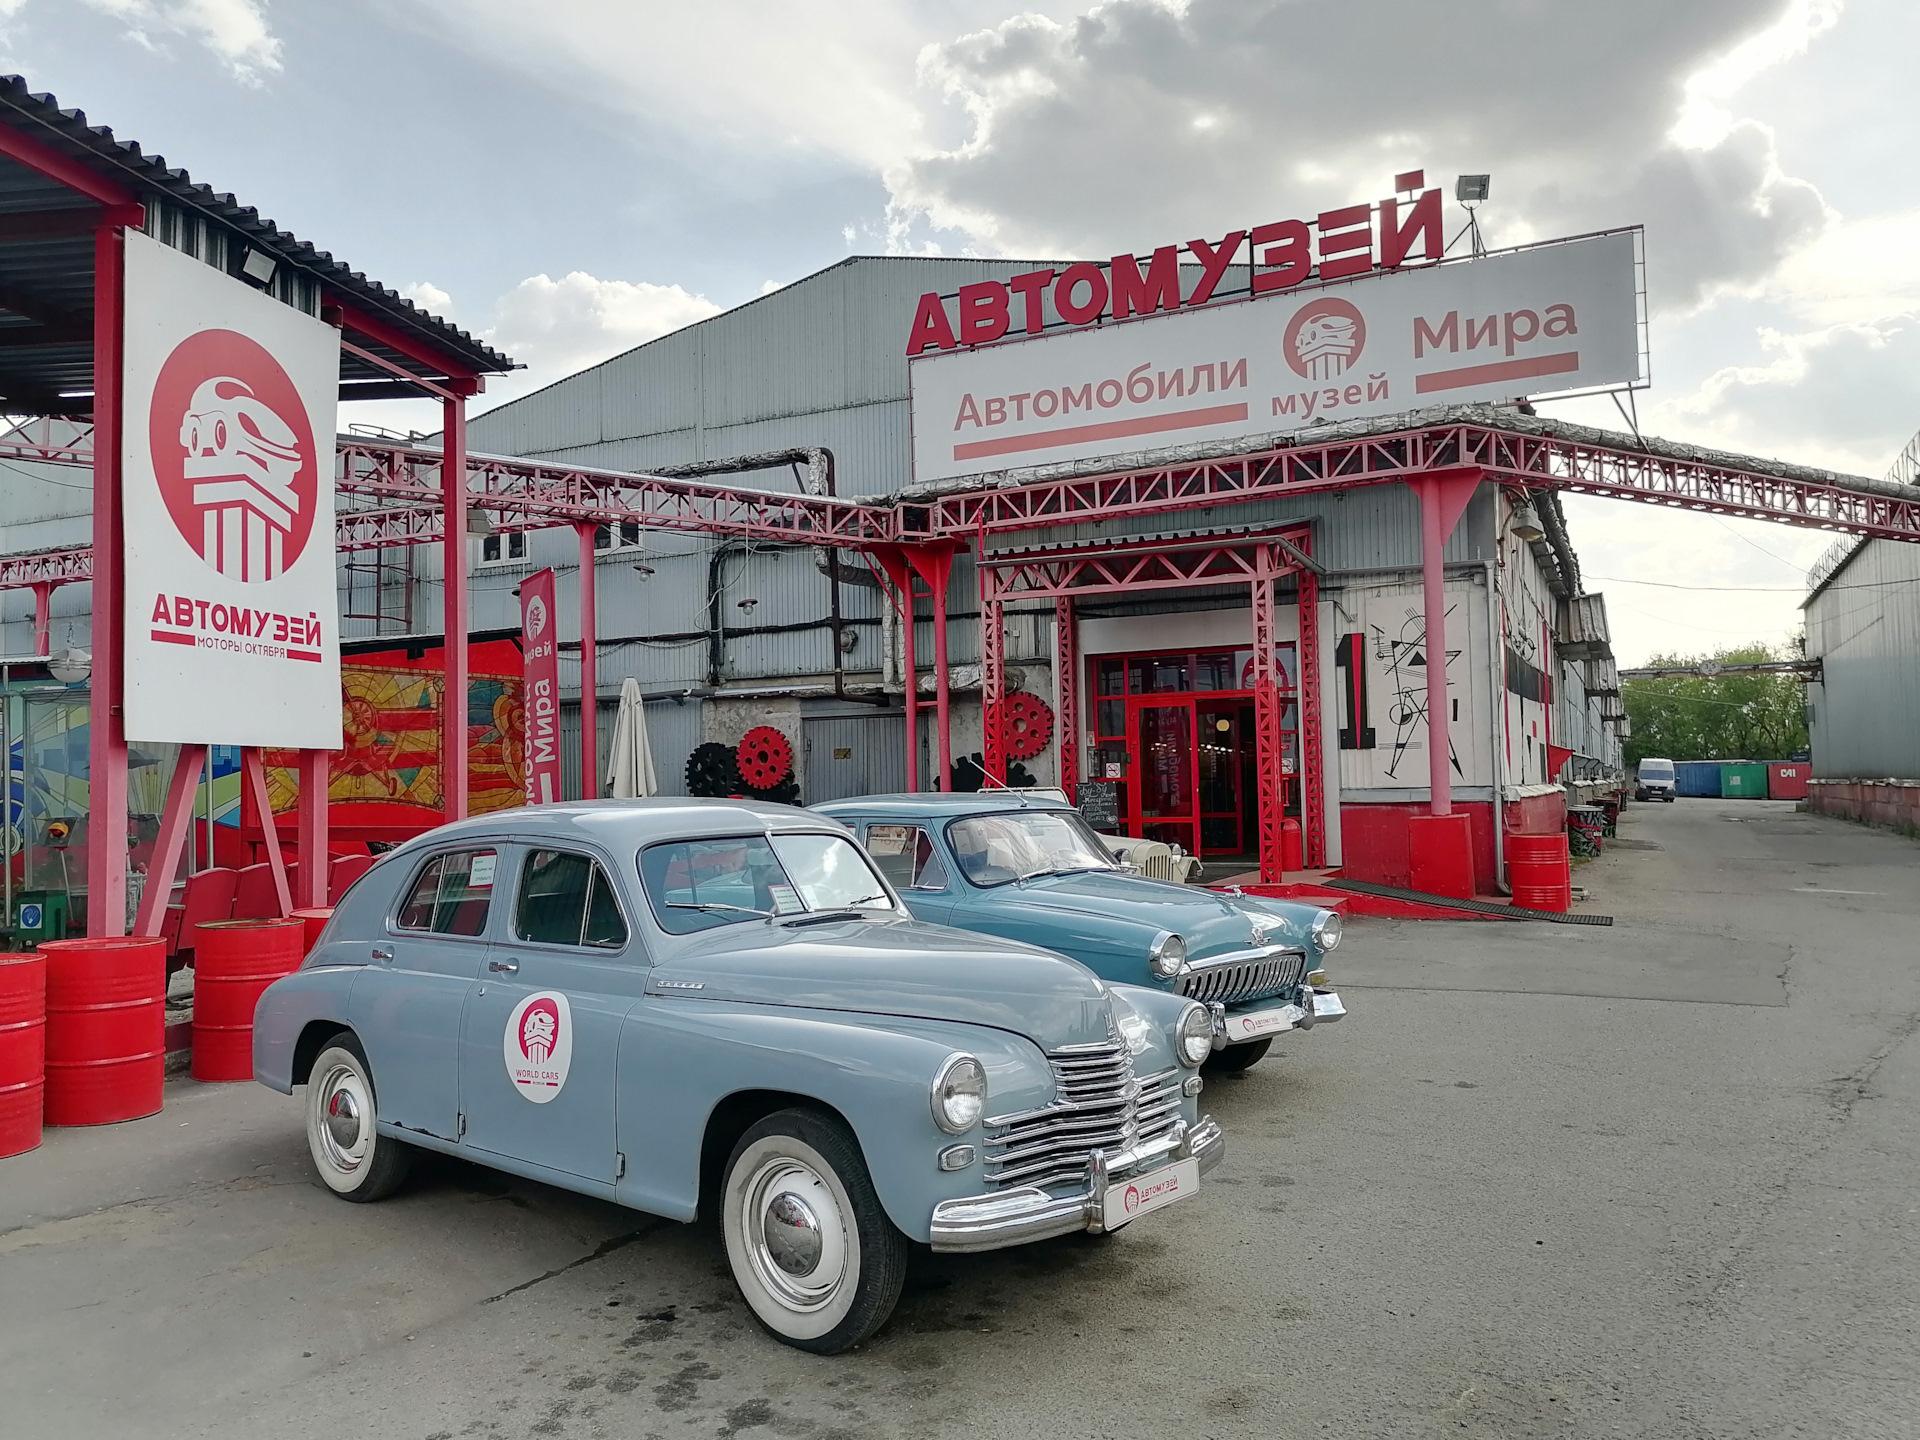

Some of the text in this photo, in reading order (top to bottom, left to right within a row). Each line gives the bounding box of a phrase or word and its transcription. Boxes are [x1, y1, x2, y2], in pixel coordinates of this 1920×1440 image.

[906, 169, 1444, 355] АВТОМУЗЕЙ
[953, 303, 1579, 431] Автомобили Мира
[1271, 372, 1391, 420] музей
[151, 593, 322, 647] АВТОМУЗЕЙ
[197, 636, 285, 659] МОТОРЫ ОКТЯБРЯ
[534, 679, 556, 763] Мира
[516, 1069, 559, 1080] WORLD CARS
[1141, 1175, 1178, 1199] АВТОМУЗЕЙ
